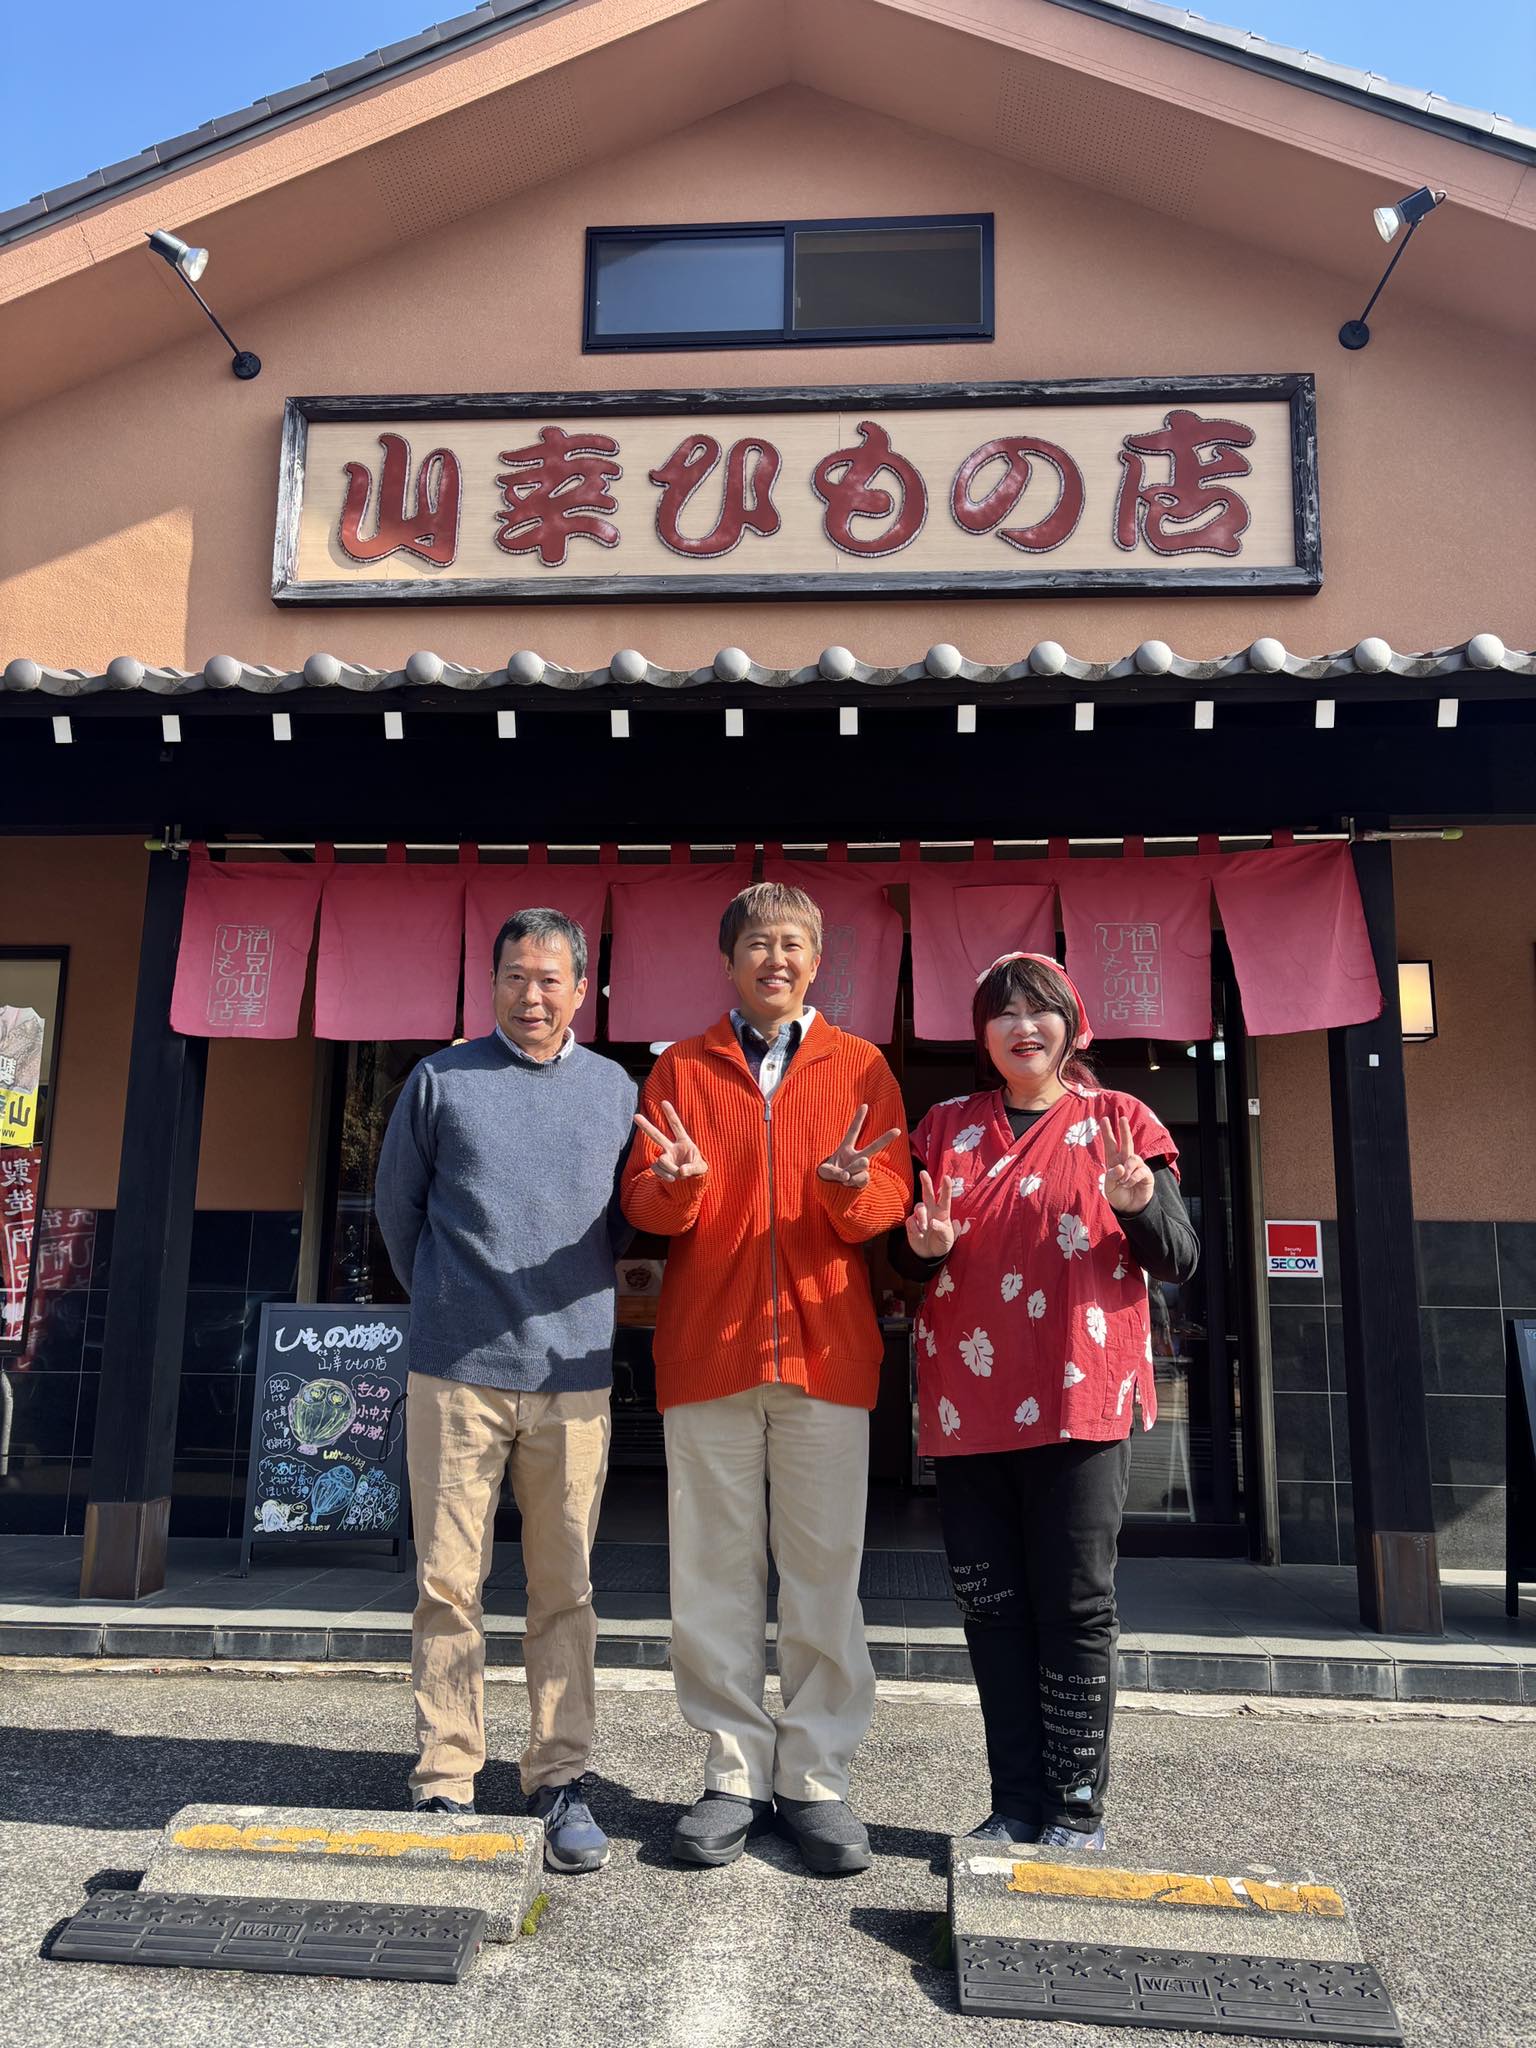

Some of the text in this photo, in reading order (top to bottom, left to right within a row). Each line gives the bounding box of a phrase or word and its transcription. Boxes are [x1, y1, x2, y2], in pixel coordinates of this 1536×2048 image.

[337, 408, 1256, 569] 山幸ひもの店
[1271, 1258, 1316, 1269] SECOM
[318, 1355, 387, 1373] 山幸ひもの店
[269, 1379, 290, 1394] BBQ
[953, 1565, 971, 1574] way
[954, 1577, 987, 1592] appy?
[973, 1588, 1015, 1606] forget
[1068, 1675, 1106, 1685] charm
[1051, 1689, 1101, 1702] carries
[1073, 1747, 1096, 1756] can
[1059, 1758, 1080, 1769] you
[241, 1923, 298, 1937] WATT
[1143, 1977, 1201, 1994] WATT
